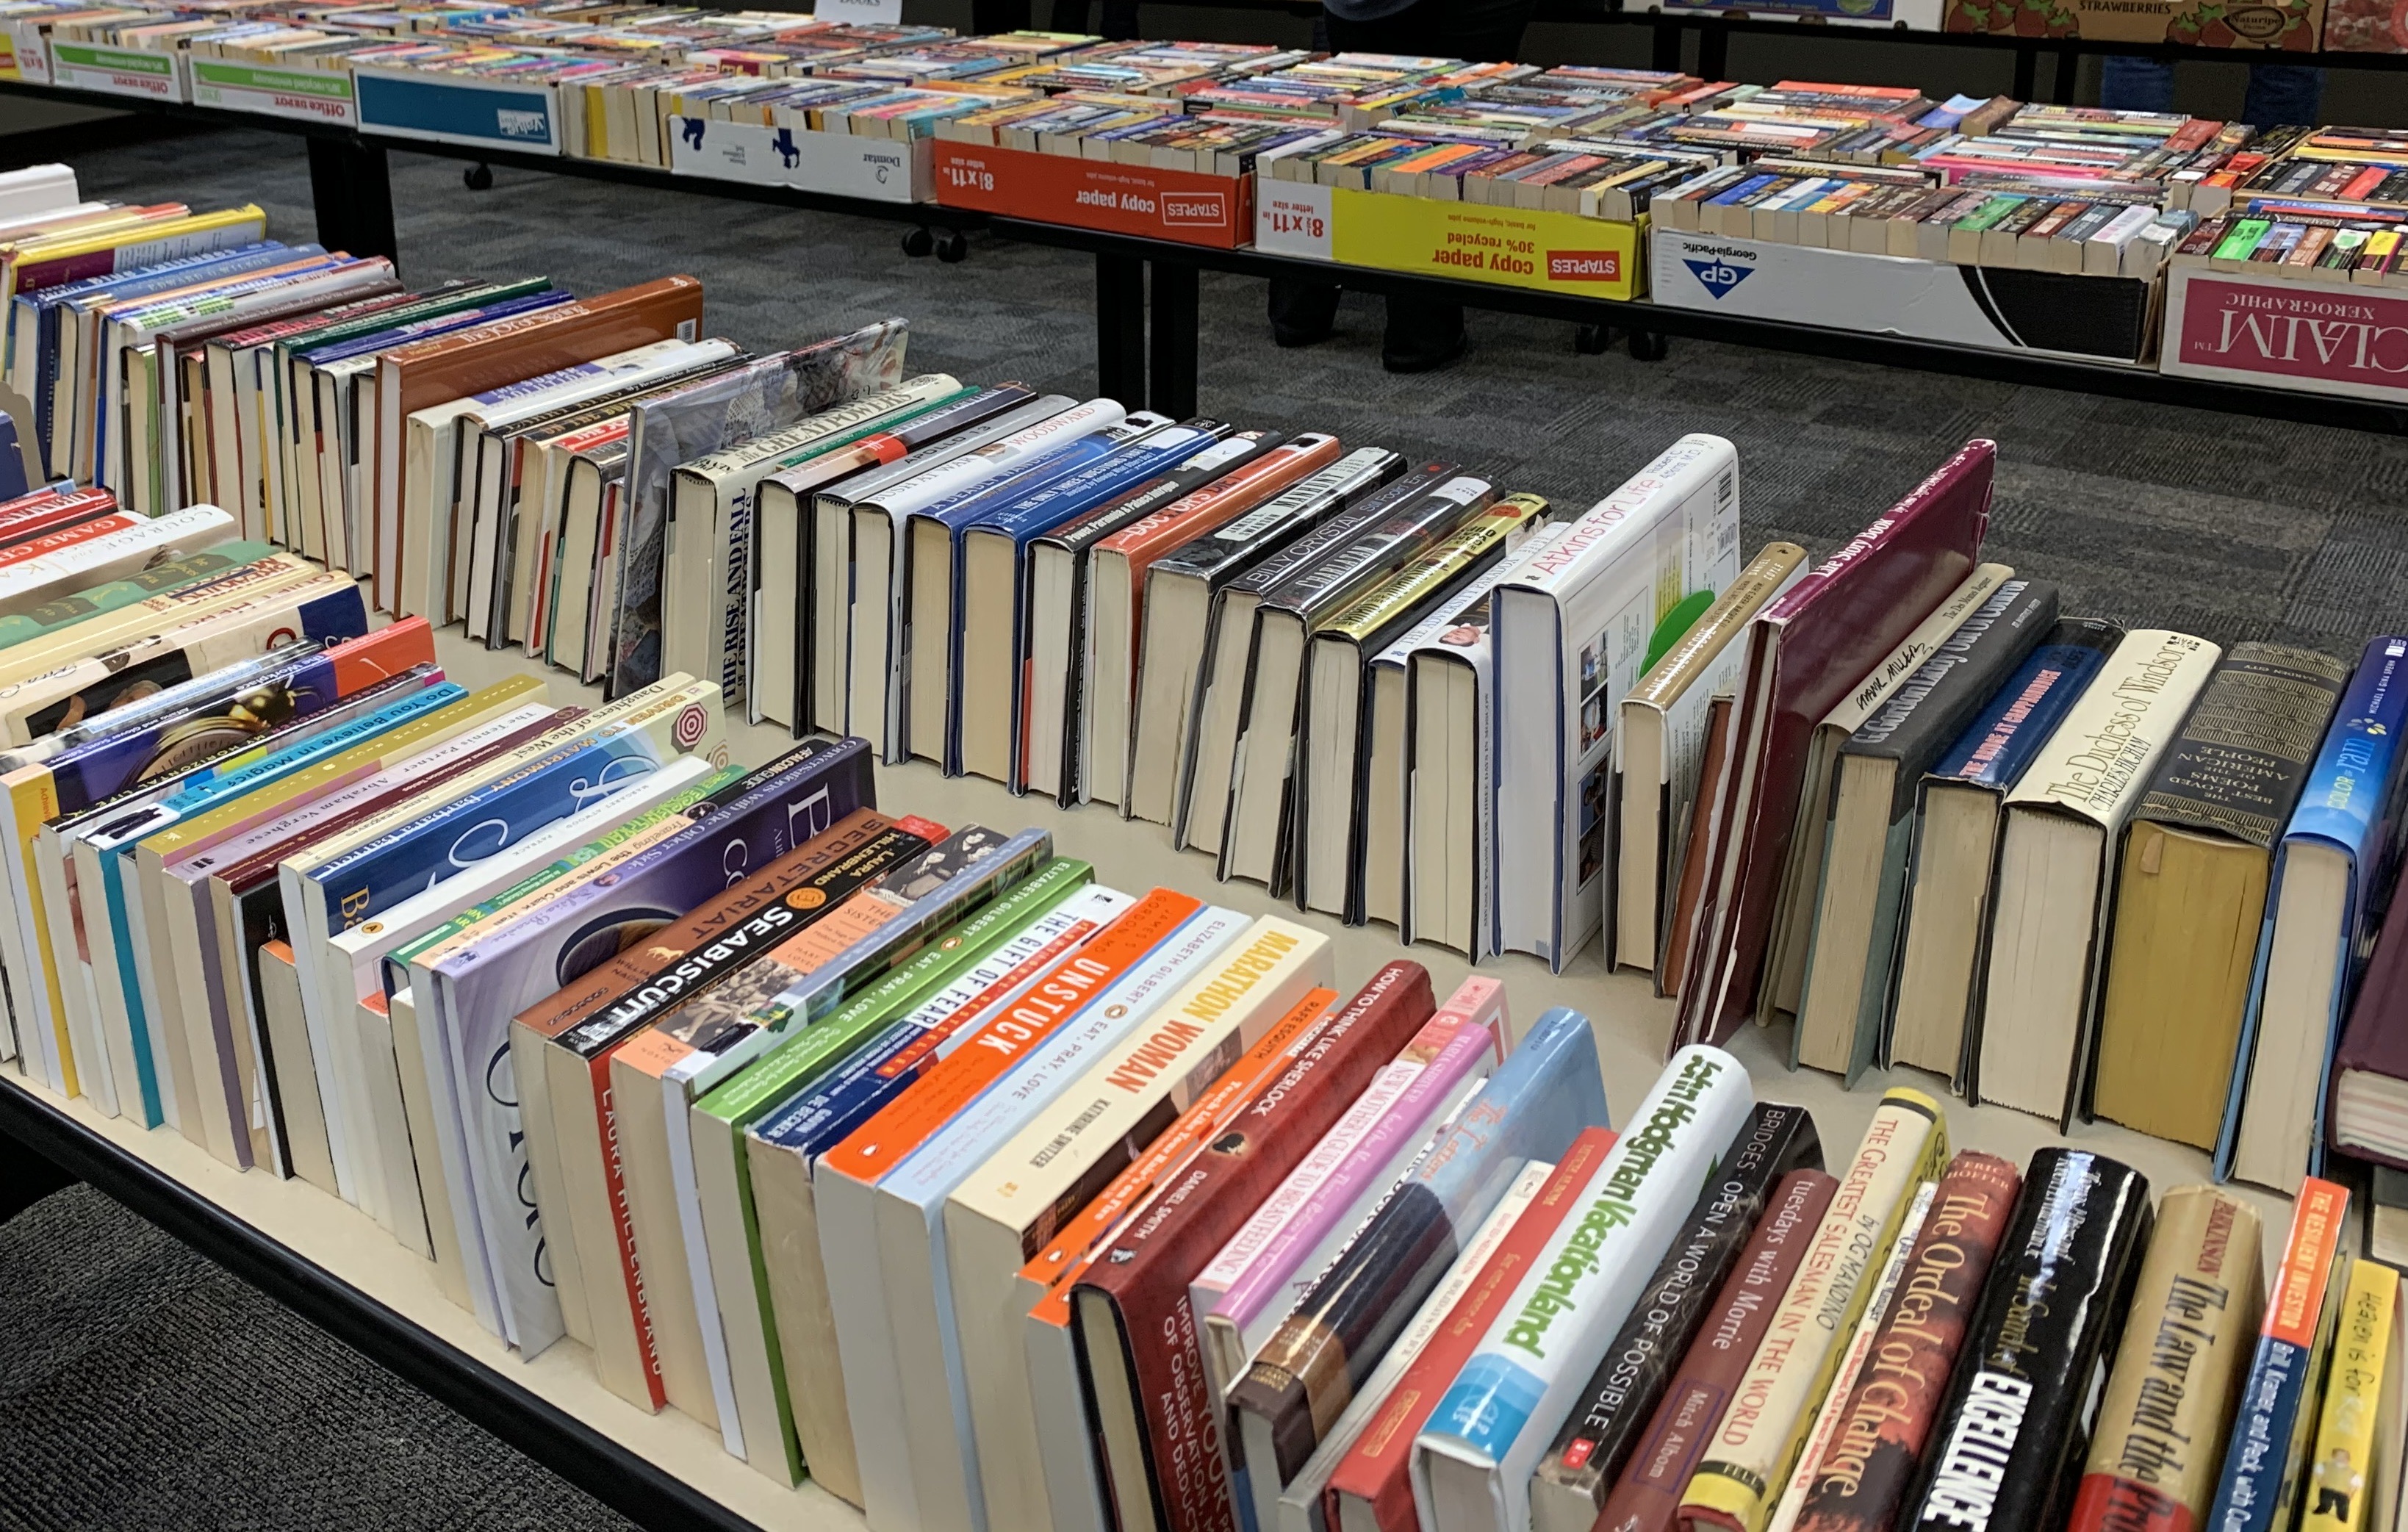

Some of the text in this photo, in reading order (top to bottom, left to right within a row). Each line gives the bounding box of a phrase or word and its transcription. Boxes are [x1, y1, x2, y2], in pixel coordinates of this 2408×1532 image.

[2080, 1, 2171, 14] STRAWBERRIES
[309, 99, 345, 118] Office
[863, 153, 901, 168] Domtar
[1076, 189, 1156, 214] copy paper
[1167, 202, 1220, 217] STAPLES
[1272, 200, 1313, 215] letter size
[1432, 248, 1534, 275] copy paper
[1447, 233, 1535, 253] 30% recycled
[1550, 258, 1615, 275] STAPLES
[1700, 267, 1738, 285] GP
[2226, 292, 2376, 320] XEROGRAPHIC
[756, 425, 824, 456] GREAT
[823, 392, 913, 430] POWERS
[905, 425, 992, 464] APOLLO 13
[874, 407, 1096, 503] BUSH AT WAR WOODWARD
[933, 442, 1079, 510] A DEADLY WANDERING
[1273, 472, 1345, 508] MANHUNT
[35, 519, 117, 547] GAME
[1239, 514, 1281, 536] SWANSON
[1532, 479, 1656, 575] Atkins for Life
[1836, 536, 1873, 561] Story
[1865, 518, 1895, 541] Book
[1246, 515, 1366, 583] BILLY CRYSTAL
[1295, 544, 1377, 589] CHARLATAN
[1747, 557, 1771, 576] DANIEL
[723, 488, 747, 699] THE RISE AND FALL
[1398, 558, 1520, 645] THE ADVERSITY PARADOX
[234, 660, 309, 691] Workplace
[2120, 646, 2187, 696] Windsor
[2243, 663, 2318, 683] GARDEN CITY
[389, 701, 423, 717] You
[425, 688, 455, 702] Do
[622, 694, 687, 726] DRIVEN
[322, 716, 389, 744] Believe
[459, 723, 508, 746] Tennis
[511, 711, 537, 724] The
[511, 684, 666, 760] Daughters of the West
[597, 724, 627, 738] TO
[403, 747, 460, 774] Partner
[489, 738, 599, 793] MATRIMONY
[2065, 706, 2143, 783] Duchess
[2200, 745, 2276, 768] PEOPLE
[95, 734, 267, 808] MY HORIZONTAL LIFE
[226, 755, 295, 791] Magic?
[762, 739, 858, 794] Conversations
[2044, 764, 2093, 804] The
[2088, 736, 2152, 813] CHARLES HIGHAM
[2176, 752, 2291, 781] AMERICAN
[2190, 772, 2260, 790] POEMS
[2204, 763, 2257, 780] OF THE
[2327, 737, 2378, 810] COLOR rain
[245, 777, 389, 846] Abraham Verghese
[564, 784, 650, 830] MARGARET ATWOOD
[729, 793, 763, 815] With
[2168, 776, 2274, 805] BEST LOVED
[2204, 791, 2232, 802] THE
[661, 824, 705, 851] Other
[705, 810, 731, 827] the
[513, 834, 554, 857] PAYBACK
[812, 832, 902, 886] HILLENBRAND
[848, 848, 896, 879] LAURA
[692, 819, 888, 941] SECRETARIAT
[962, 860, 1071, 938] ELIZABETH GILBERT
[866, 904, 896, 921] THE
[1035, 910, 1082, 937] THE
[1001, 935, 1044, 965] GIFT
[1126, 919, 1226, 1006] ELIZABETH GILBERT
[575, 905, 795, 1043] SEABISCUIT
[836, 951, 942, 1023] EAT, PRAY, LOVE
[966, 968, 999, 990] OF
[977, 957, 1111, 1057] UNSTUCK
[1104, 929, 1300, 1093] MARATHON WOMAN
[1250, 967, 1405, 1116] HOW TO THINK LIKE SHERLOCK
[1253, 999, 1321, 1060] RAFE ESQUITH
[1874, 1118, 1900, 1148] THE
[1840, 1146, 1888, 1226] GREATEST
[1963, 1161, 1999, 1175] ERIC
[1132, 1168, 1207, 1240] DANIEL SMITH
[1931, 1192, 1990, 1238] The
[2313, 1191, 2333, 1215] THE
[1502, 1195, 1637, 1360] Vacationland
[1584, 1108, 1786, 1431] BRIDGES OPEN A WORLD OF POSSIBLE
[1711, 1178, 1815, 1352] tuesdays with Morrie
[1794, 1223, 1850, 1314] SALESMAN
[1815, 1213, 1882, 1332] by OG MANDINO
[1893, 1242, 1966, 1346] Ordeal
[2166, 1273, 2229, 1315] The
[2280, 1267, 2312, 1330] INVESTOR
[1163, 1316, 1176, 1345] OF
[1778, 1310, 1802, 1334] IN
[1755, 1333, 1793, 1378] THE
[1872, 1345, 1927, 1389] of
[2150, 1315, 2216, 1381] Law
[1161, 1392, 1178, 1440] AND
[1174, 1294, 1229, 1512] IMPROVE YOUR
[1722, 1373, 1776, 1449] WORLD
[2132, 1378, 2192, 1445] and
[1648, 1388, 1709, 1480] Mitch Albom
[1822, 1386, 1913, 1498] Change
[1922, 1370, 2034, 1532] EXCELLENCE
[2117, 1433, 2185, 1485] the
